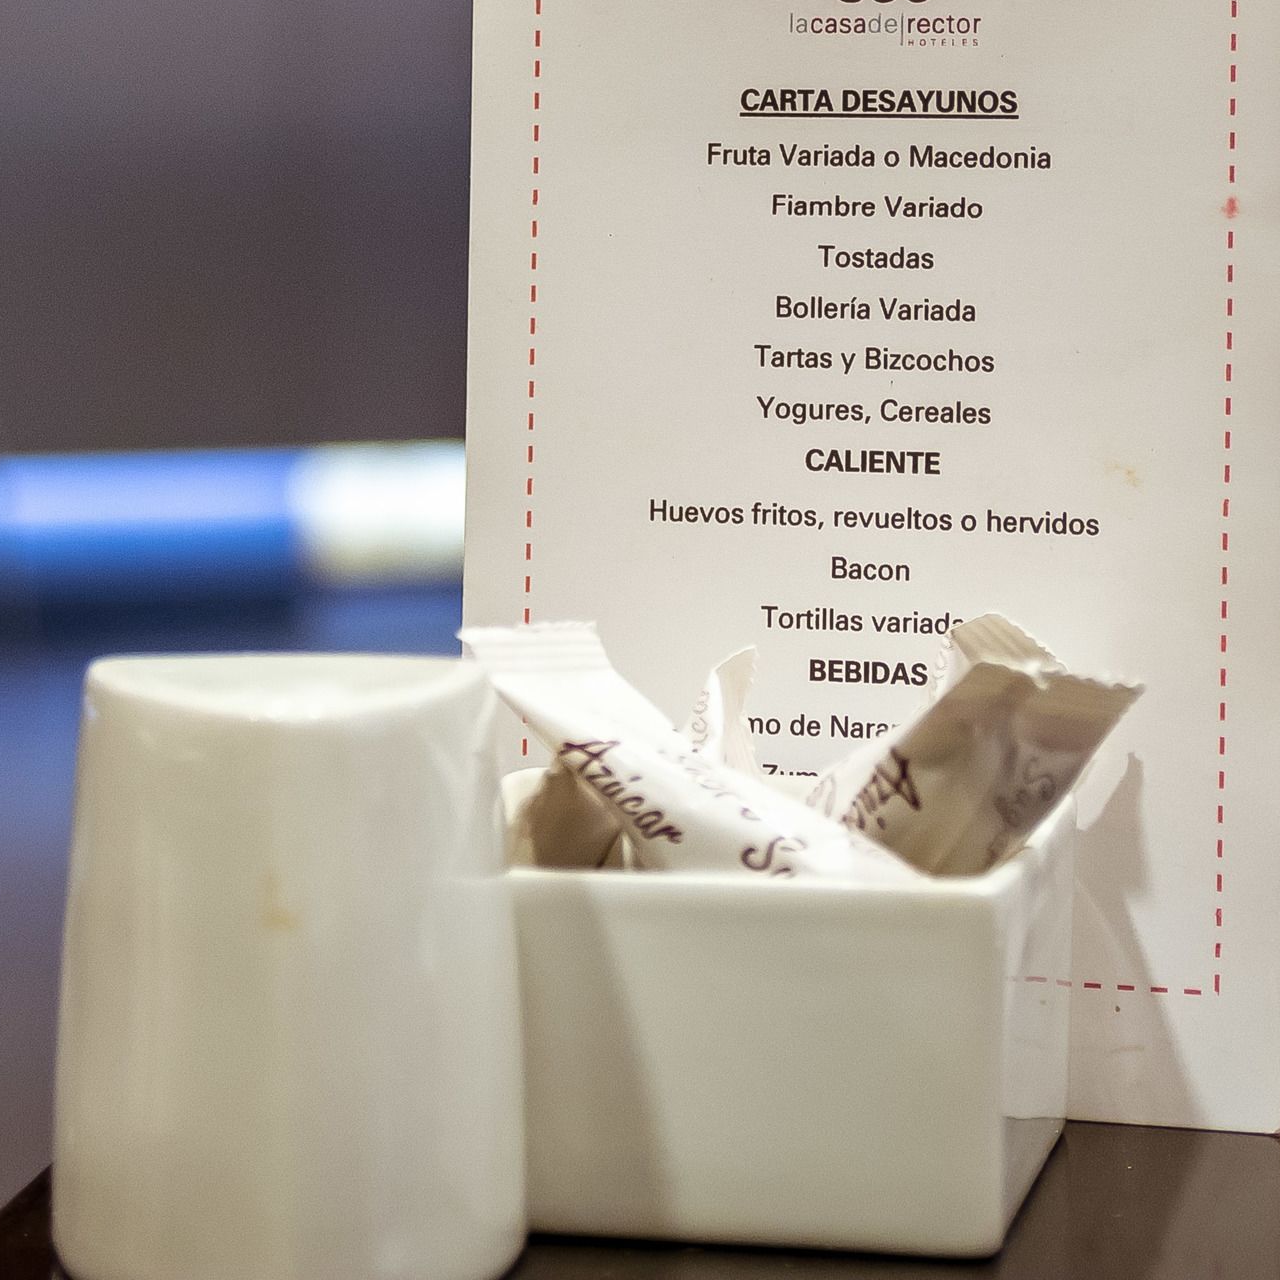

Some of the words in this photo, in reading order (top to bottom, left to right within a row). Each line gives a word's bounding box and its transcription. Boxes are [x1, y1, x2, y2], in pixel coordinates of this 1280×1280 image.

[740, 88, 835, 113] CARTA
[841, 89, 1019, 114] DESAYUNOS
[707, 142, 772, 167] Fruta
[778, 143, 876, 169] Variada
[883, 150, 901, 169] o
[909, 144, 1052, 171] Macedonia
[772, 194, 877, 219] Fiambre
[884, 195, 984, 220] Variado
[817, 244, 935, 271] Tostadas
[776, 295, 872, 321] Bollería
[878, 297, 977, 323] Variada
[753, 344, 834, 370] Tartas
[840, 352, 857, 376] y
[865, 346, 996, 374] Bizcochos
[756, 395, 872, 426] Yogures,
[880, 398, 992, 426] Cereales
[805, 448, 942, 476] CALIENTE
[650, 498, 745, 526] Huevos
[751, 502, 825, 531] fritos,
[833, 507, 954, 532] revueltos
[960, 514, 978, 533] o
[987, 509, 1101, 537] hervidos
[831, 556, 911, 583] Bacon
[760, 605, 864, 633] Tortillas
[871, 611, 964, 635] variad
[809, 659, 929, 687] BEBIDAS
[789, 714, 821, 737] de
